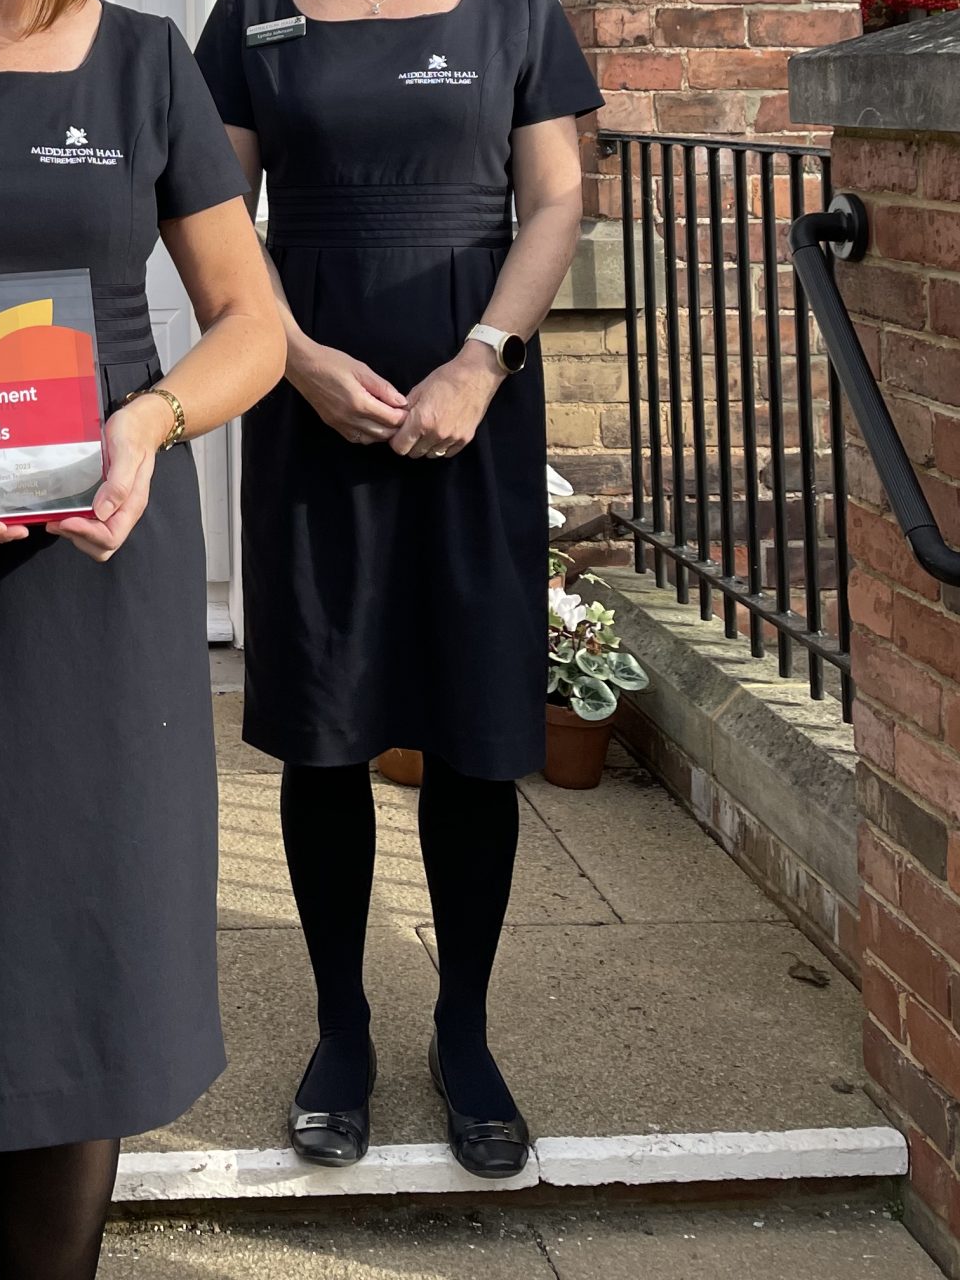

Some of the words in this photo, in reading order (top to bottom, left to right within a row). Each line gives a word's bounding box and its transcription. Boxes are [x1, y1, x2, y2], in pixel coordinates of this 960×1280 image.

[398, 71, 452, 79] MIDDLETON
[31, 147, 94, 156] MIDDLETON
[96, 148, 123, 158] HALL
[40, 156, 86, 164] RETIREMENT
[87, 156, 117, 165] VILLAGE
